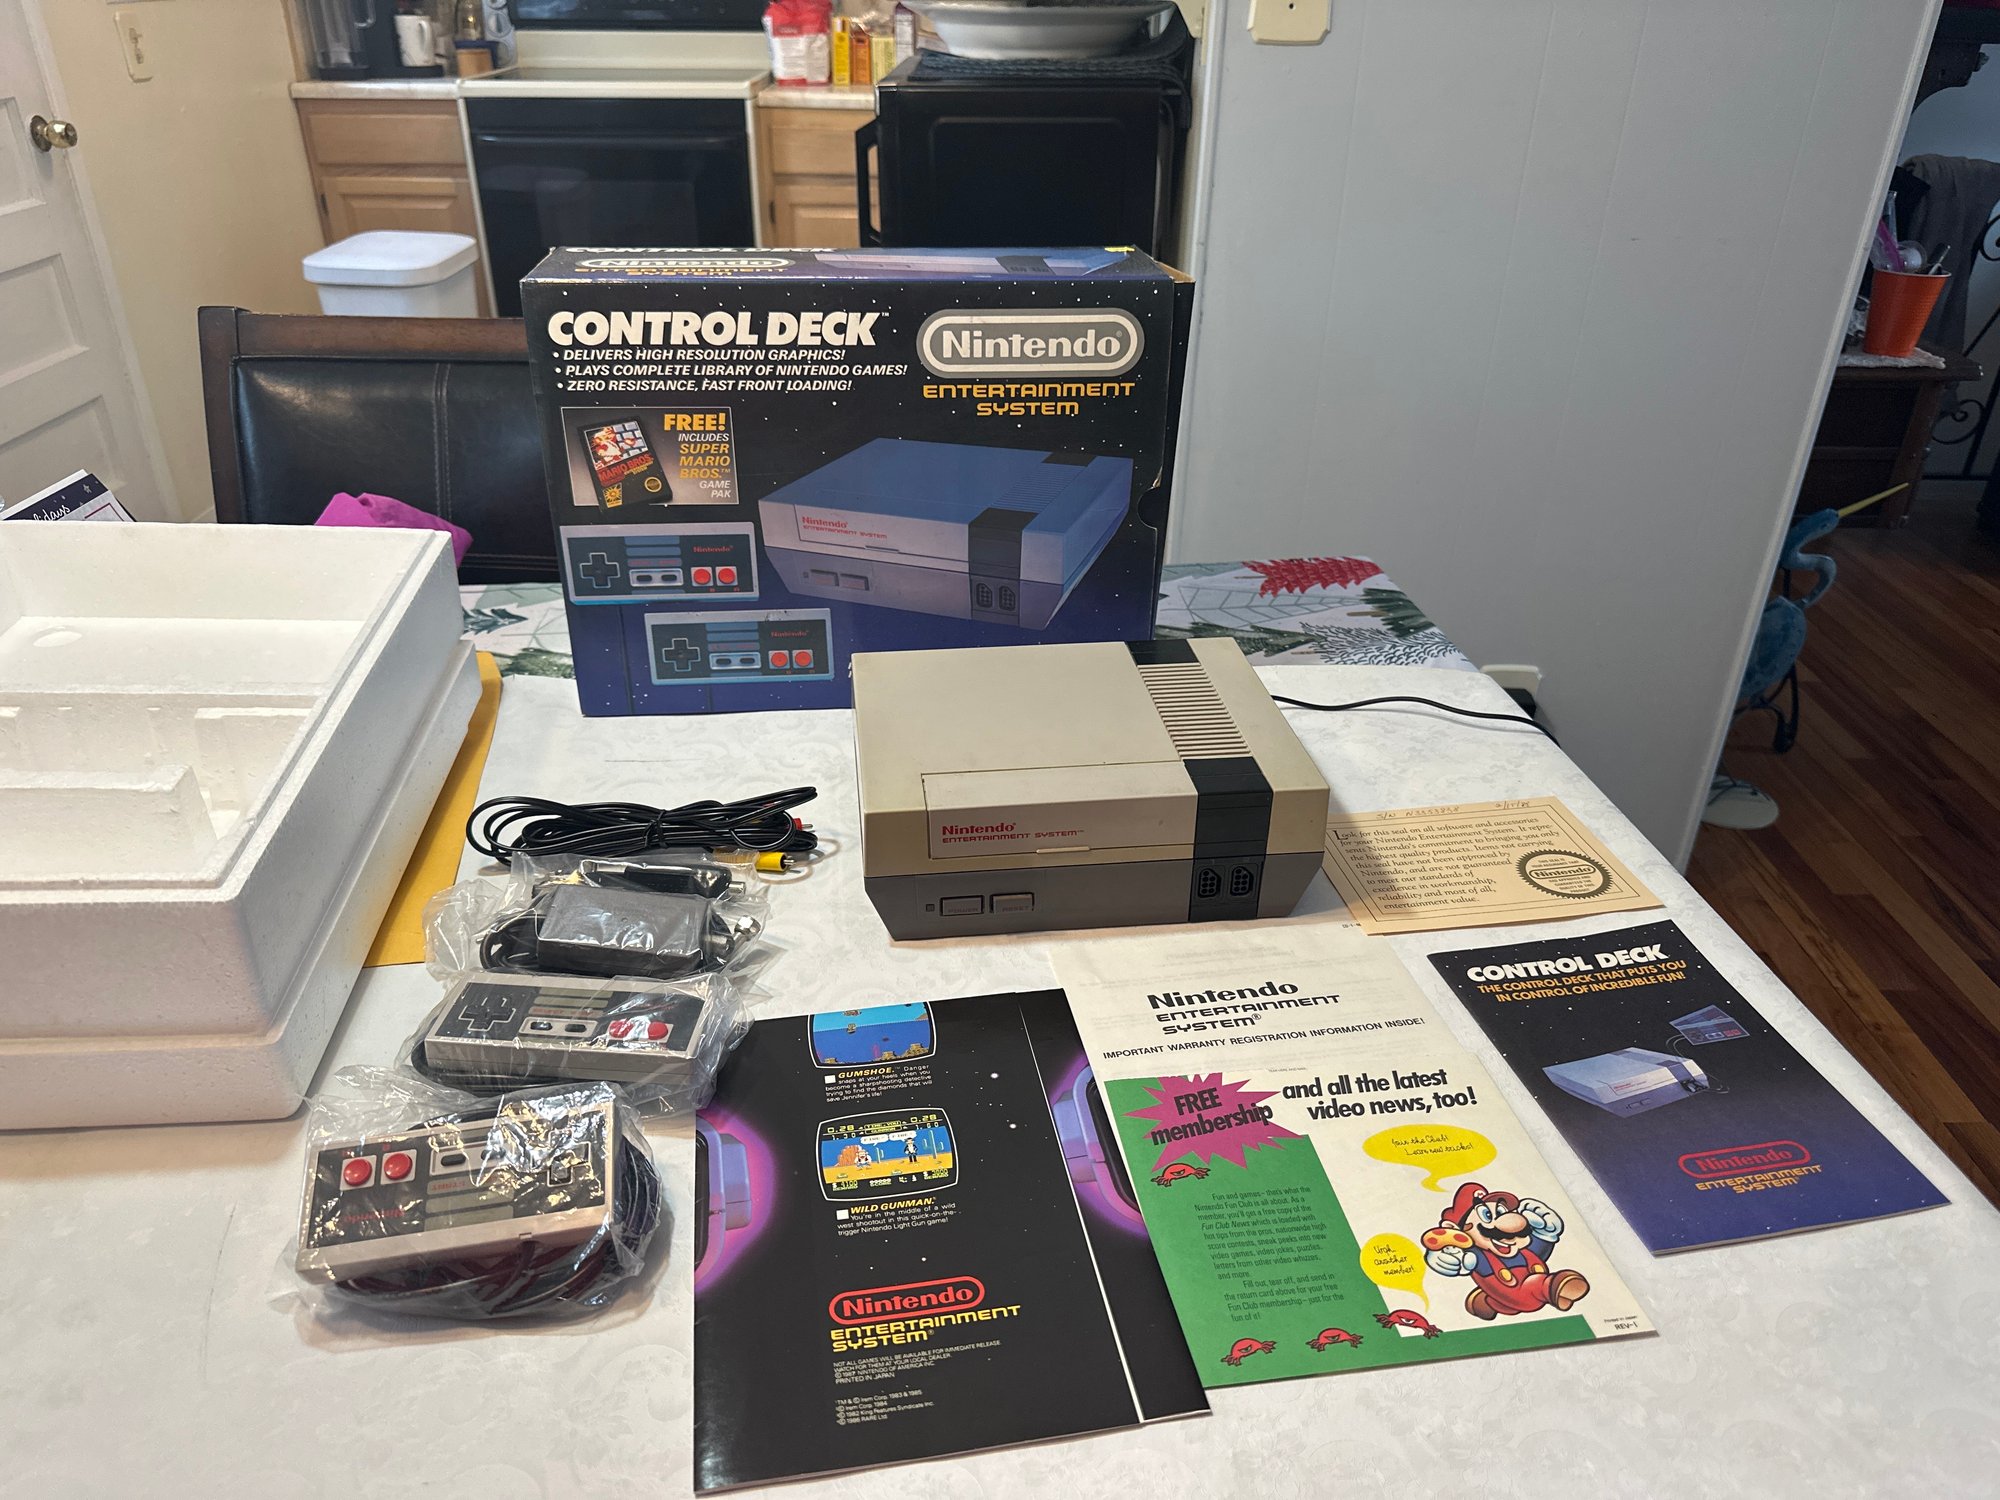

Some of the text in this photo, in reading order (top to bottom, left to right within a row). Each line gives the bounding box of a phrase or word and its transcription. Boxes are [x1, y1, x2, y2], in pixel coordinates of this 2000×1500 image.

[548, 311, 758, 346] CONTROL
[942, 329, 1122, 358] Nintendo
[563, 349, 845, 362] DELIVERS HIGH RESOLUTION GRAPHICS!
[565, 364, 907, 377] PLAYS COMPLETE LIBRARY OF NINTENDO GAMES!
[567, 378, 852, 391] ZERO RESISTANCE, FAST FRONT LOADING!
[923, 382, 1135, 399] ENTERTAINMENT
[976, 402, 1079, 416] SYSTEM
[663, 412, 727, 431] FREE!
[678, 433, 729, 442] INCLUDES
[679, 443, 729, 454] SUPER
[679, 456, 731, 466] MARIO
[699, 480, 731, 489] GAME
[711, 490, 731, 498] PAK
[802, 516, 848, 528] Nintendo
[942, 822, 1016, 836] Nintendo
[942, 833, 1031, 843] ENTERTAINMENT
[1374, 834, 1417, 843] Nintendo
[1417, 830, 1482, 840] Entertainment
[1366, 842, 1416, 851] Nintendo's
[1417, 839, 1473, 848] commitment
[1456, 851, 1498, 861] approved
[1423, 889, 1442, 897] and
[1467, 886, 1478, 894] of
[1383, 895, 1479, 908] entertainment value.
[1466, 943, 1668, 981] CONTROL DECK
[1476, 959, 1686, 993] THE CONTROL DECK THAT PUTS YOU
[1495, 971, 1686, 1002] IN CONTROL OF INCREDIBLE FUN!
[1146, 981, 1298, 1010] Nintendo
[1156, 994, 1341, 1023] ENTERTAINMENT
[1102, 1017, 1424, 1058] IMPORTANT WARRANTY REGISTRATION INFORMATION INSIDE!
[838, 1066, 897, 1078] GUMSHOE.
[1282, 1068, 1447, 1099] and all the latest
[1173, 1087, 1222, 1117] FREE
[1306, 1085, 1477, 1120] video news, too!
[1151, 1102, 1274, 1146] membership
[1697, 1147, 1792, 1174] Nintendo
[1695, 1164, 1822, 1191] ENTERTAINMENT
[850, 1204, 878, 1214] WILD
[837, 1228, 859, 1236] trigger
[860, 1224, 892, 1232] Nintendo
[926, 1216, 948, 1225] game!
[855, 1218, 886, 1226] shootout
[842, 1286, 974, 1317] Nintendo
[830, 1305, 1021, 1340] ENTERTAINMENT
